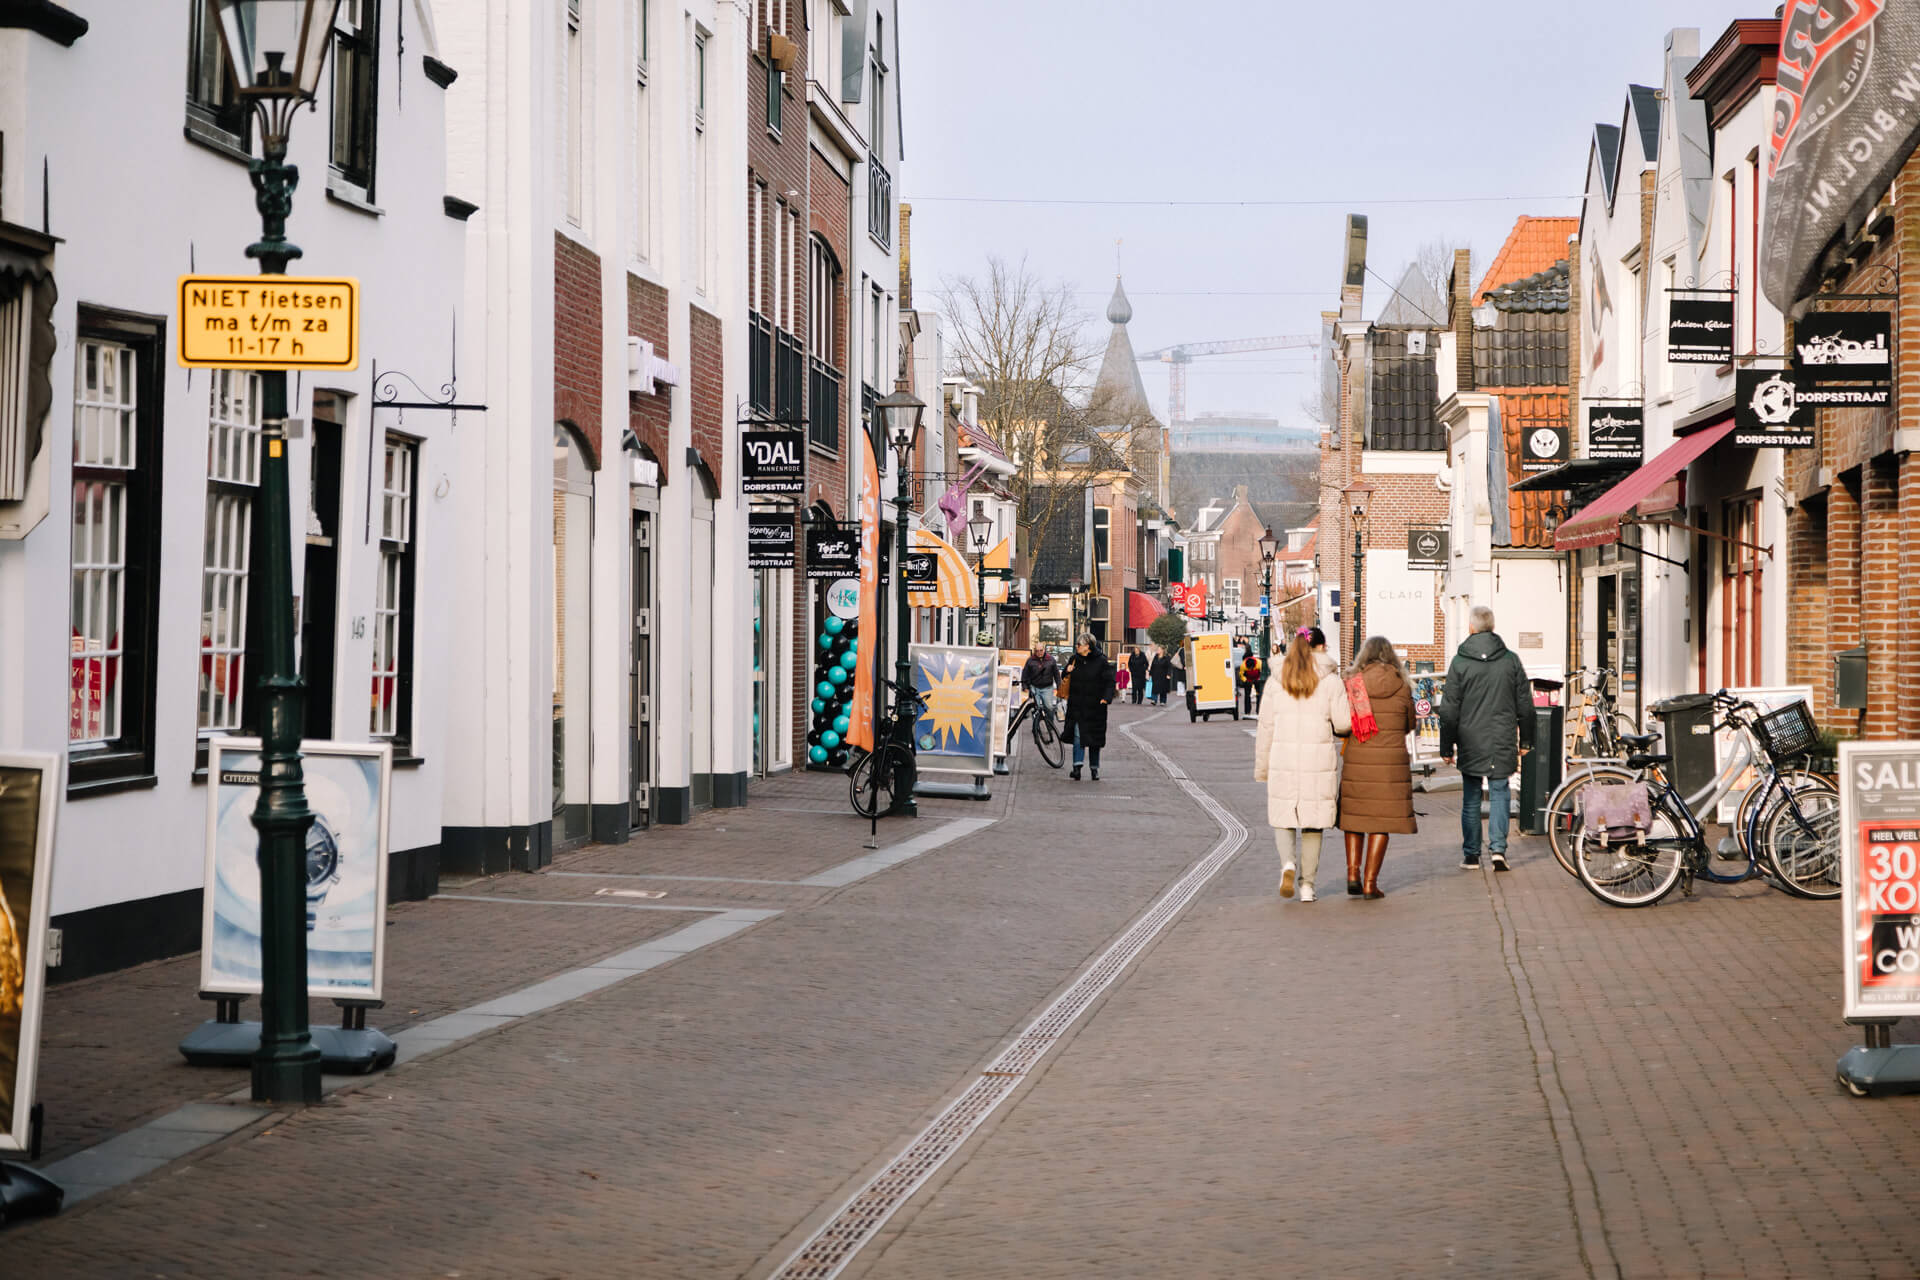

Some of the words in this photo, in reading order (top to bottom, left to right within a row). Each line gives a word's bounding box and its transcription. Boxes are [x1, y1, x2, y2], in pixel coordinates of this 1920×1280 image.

[192, 289, 249, 307] NIET
[260, 290, 342, 309] fietsen
[205, 316, 238, 331] ma
[249, 312, 291, 333] t/m
[302, 318, 328, 332] za
[228, 336, 280, 355] 11-17
[291, 337, 304, 356] h
[1669, 352, 1731, 361] DORPSSTRAAT
[1795, 391, 1888, 403] DORPSSTRAAT
[1736, 434, 1813, 445] DORPSSTRAAT
[744, 483, 803, 491] DORPSSTRAAT
[223, 774, 260, 784] CITIZEN
[1872, 831, 1895, 841] HEEL
[1896, 830, 1918, 841] VEEL
